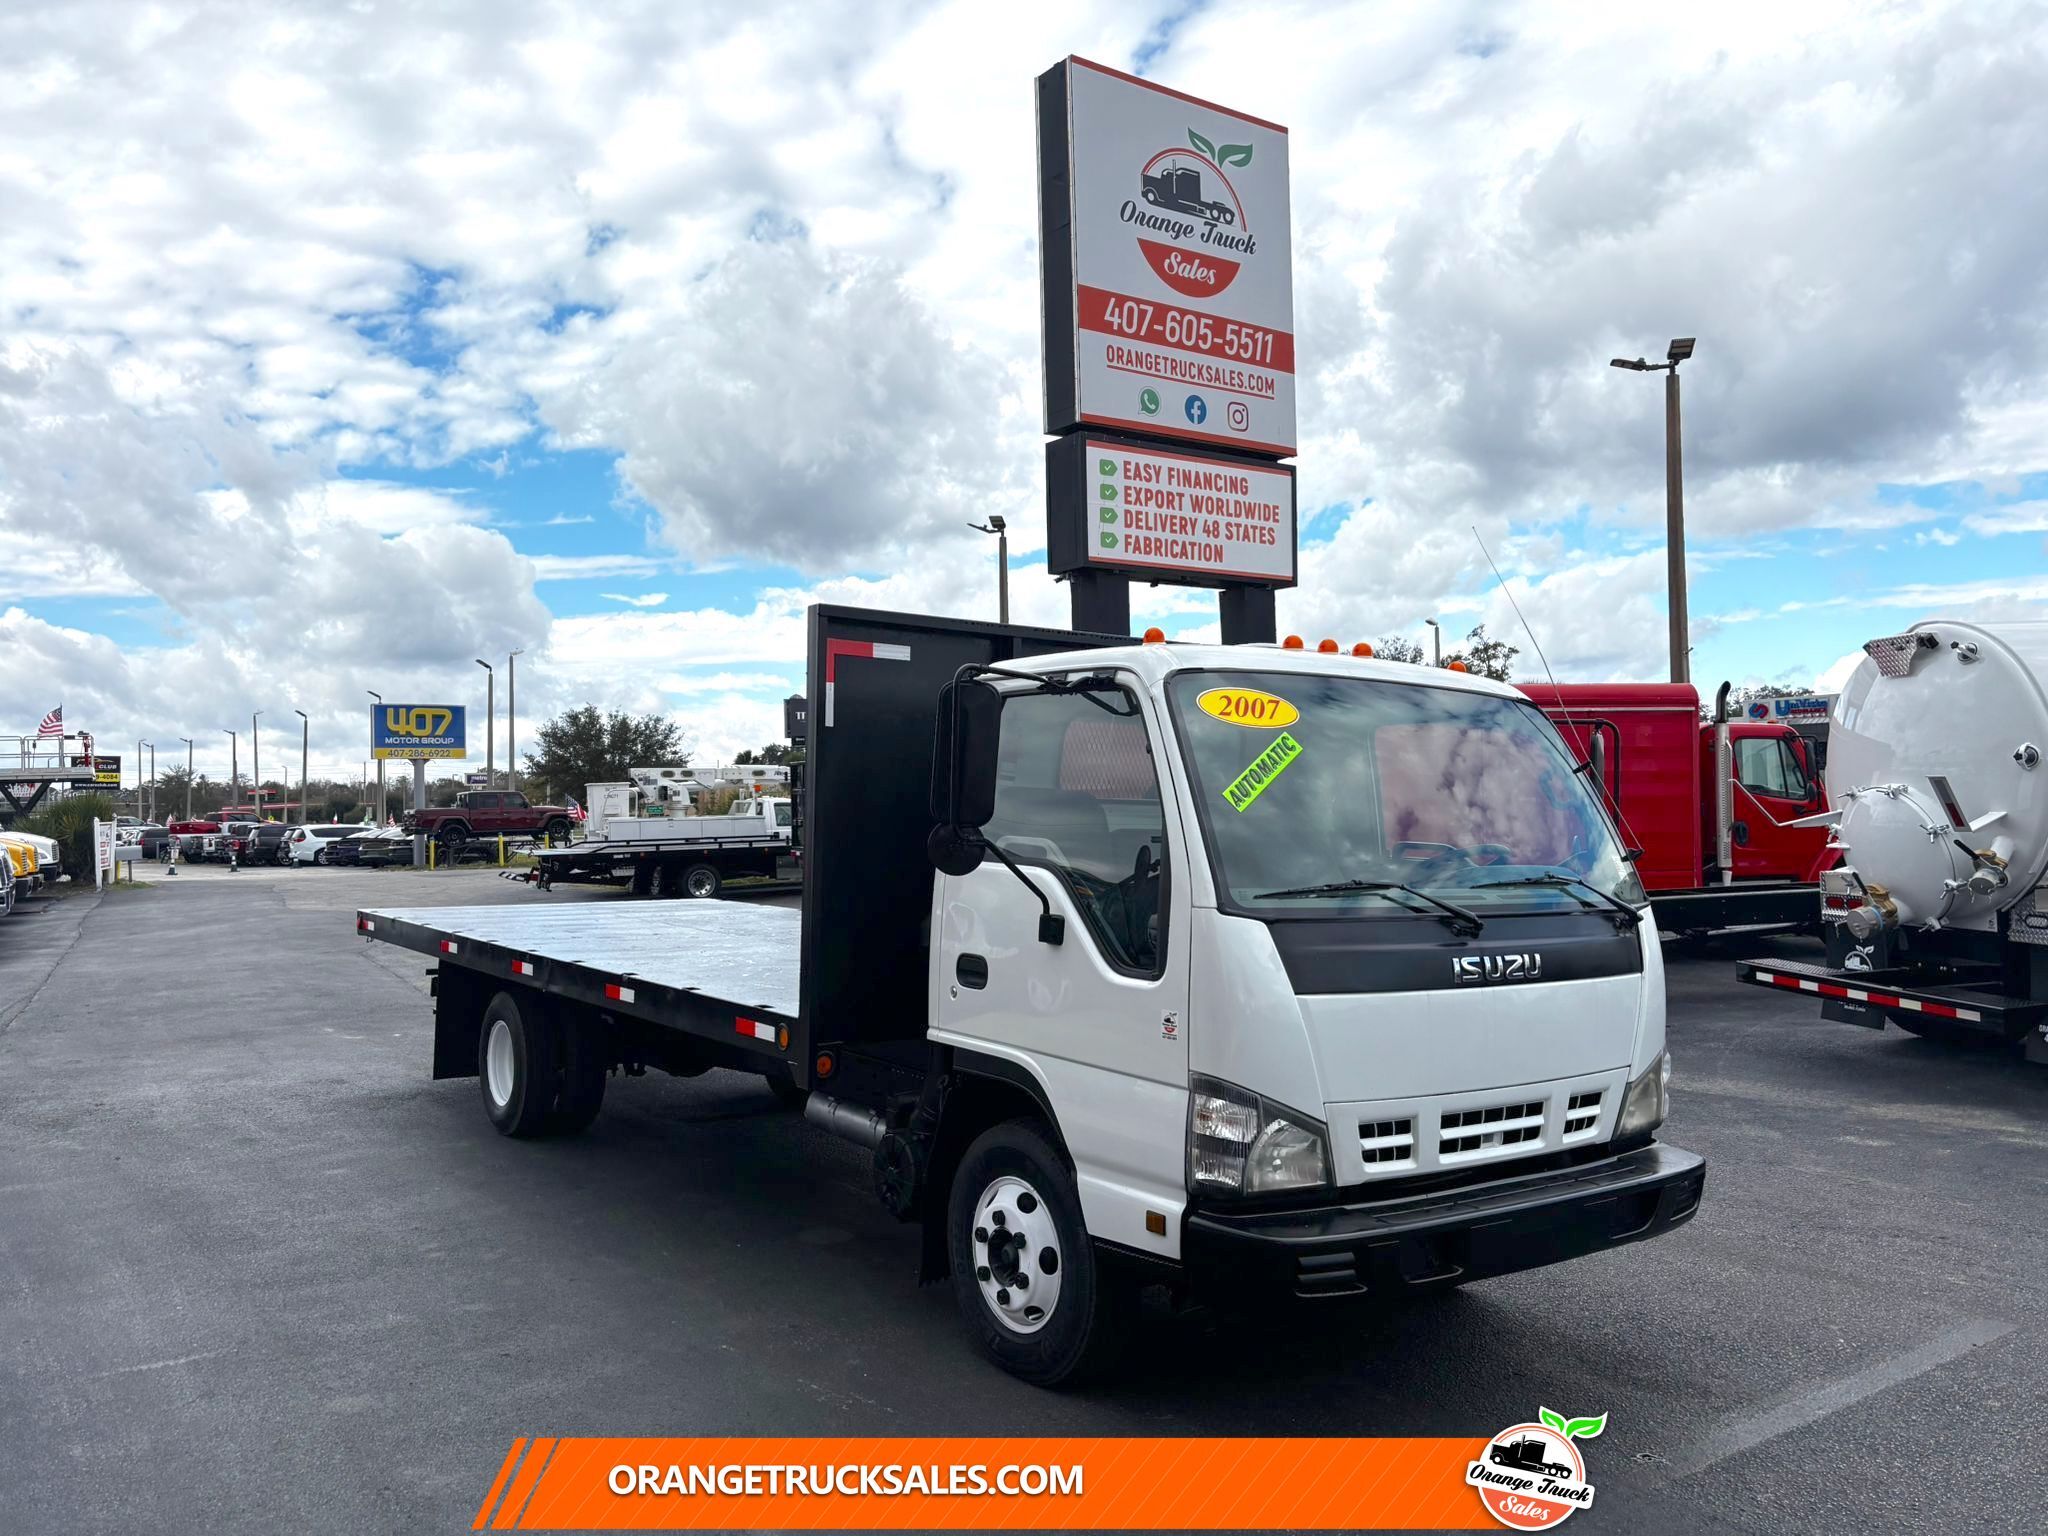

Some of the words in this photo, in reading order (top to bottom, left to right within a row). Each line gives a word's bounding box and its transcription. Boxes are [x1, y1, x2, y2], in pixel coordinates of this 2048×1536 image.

[1119, 200, 1196, 241] Orange
[1199, 221, 1257, 256] Truck
[1163, 252, 1217, 285] Sales
[1104, 297, 1274, 364] 407-605-5511
[1106, 344, 1275, 395] ORANGETRUCKSALES.COM
[1123, 460, 1162, 485] EASY
[1167, 467, 1249, 496] FINANCING
[1123, 486, 1185, 512] EXPORT
[1189, 494, 1280, 523] WORLDWIDE
[1123, 509, 1198, 536] DELIVERY
[1202, 519, 1221, 539] 48
[1225, 523, 1276, 546] STATES
[1124, 533, 1224, 563] FABRICATION
[386, 707, 453, 737] 407
[1218, 695, 1281, 720] 2007
[384, 737, 420, 745] MOTOR
[420, 737, 455, 745] GROUP
[387, 749, 452, 758] 407-286-6922
[1228, 735, 1297, 808] AUTOMATIC
[1452, 953, 1542, 984] ISUZU
